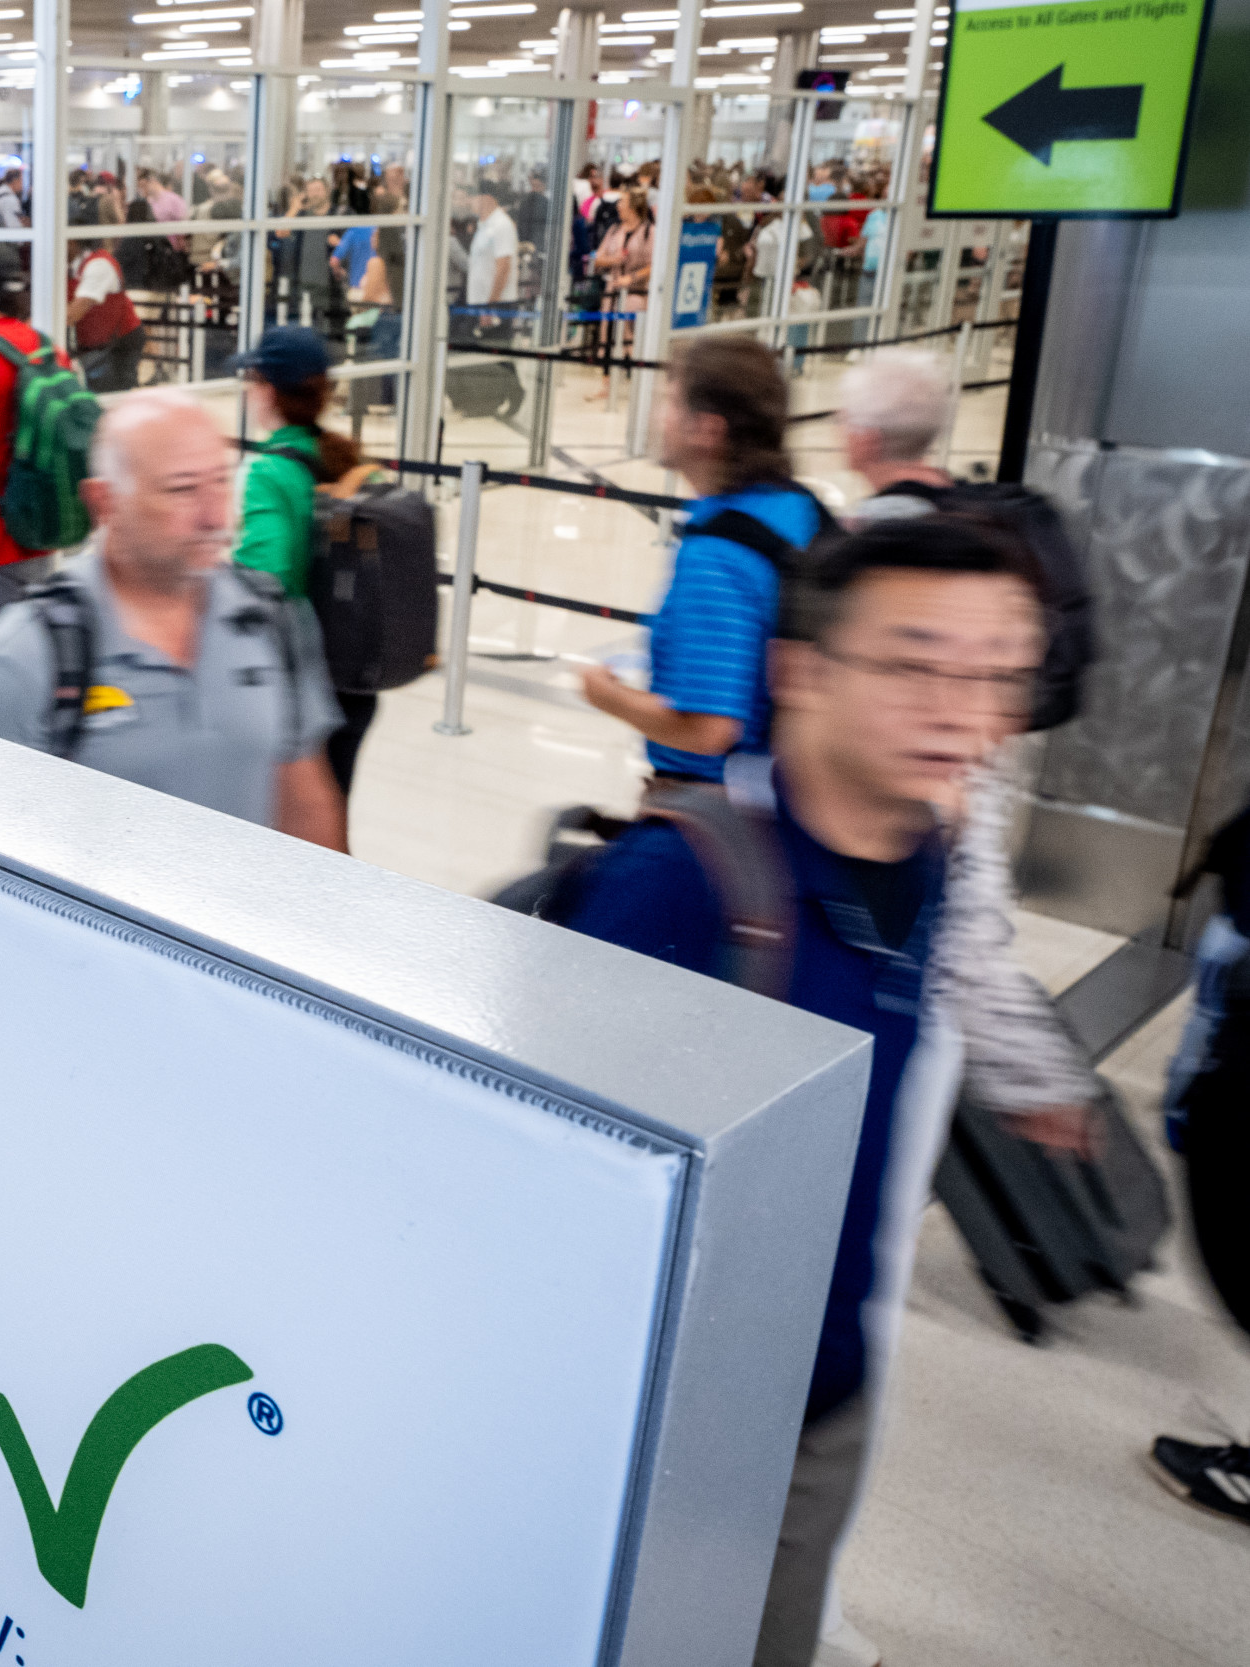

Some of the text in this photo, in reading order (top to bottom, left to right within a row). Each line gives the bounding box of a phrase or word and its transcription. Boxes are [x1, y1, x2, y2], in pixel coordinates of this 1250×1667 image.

[966, 1, 1188, 32] Access to All Gates and Flights
